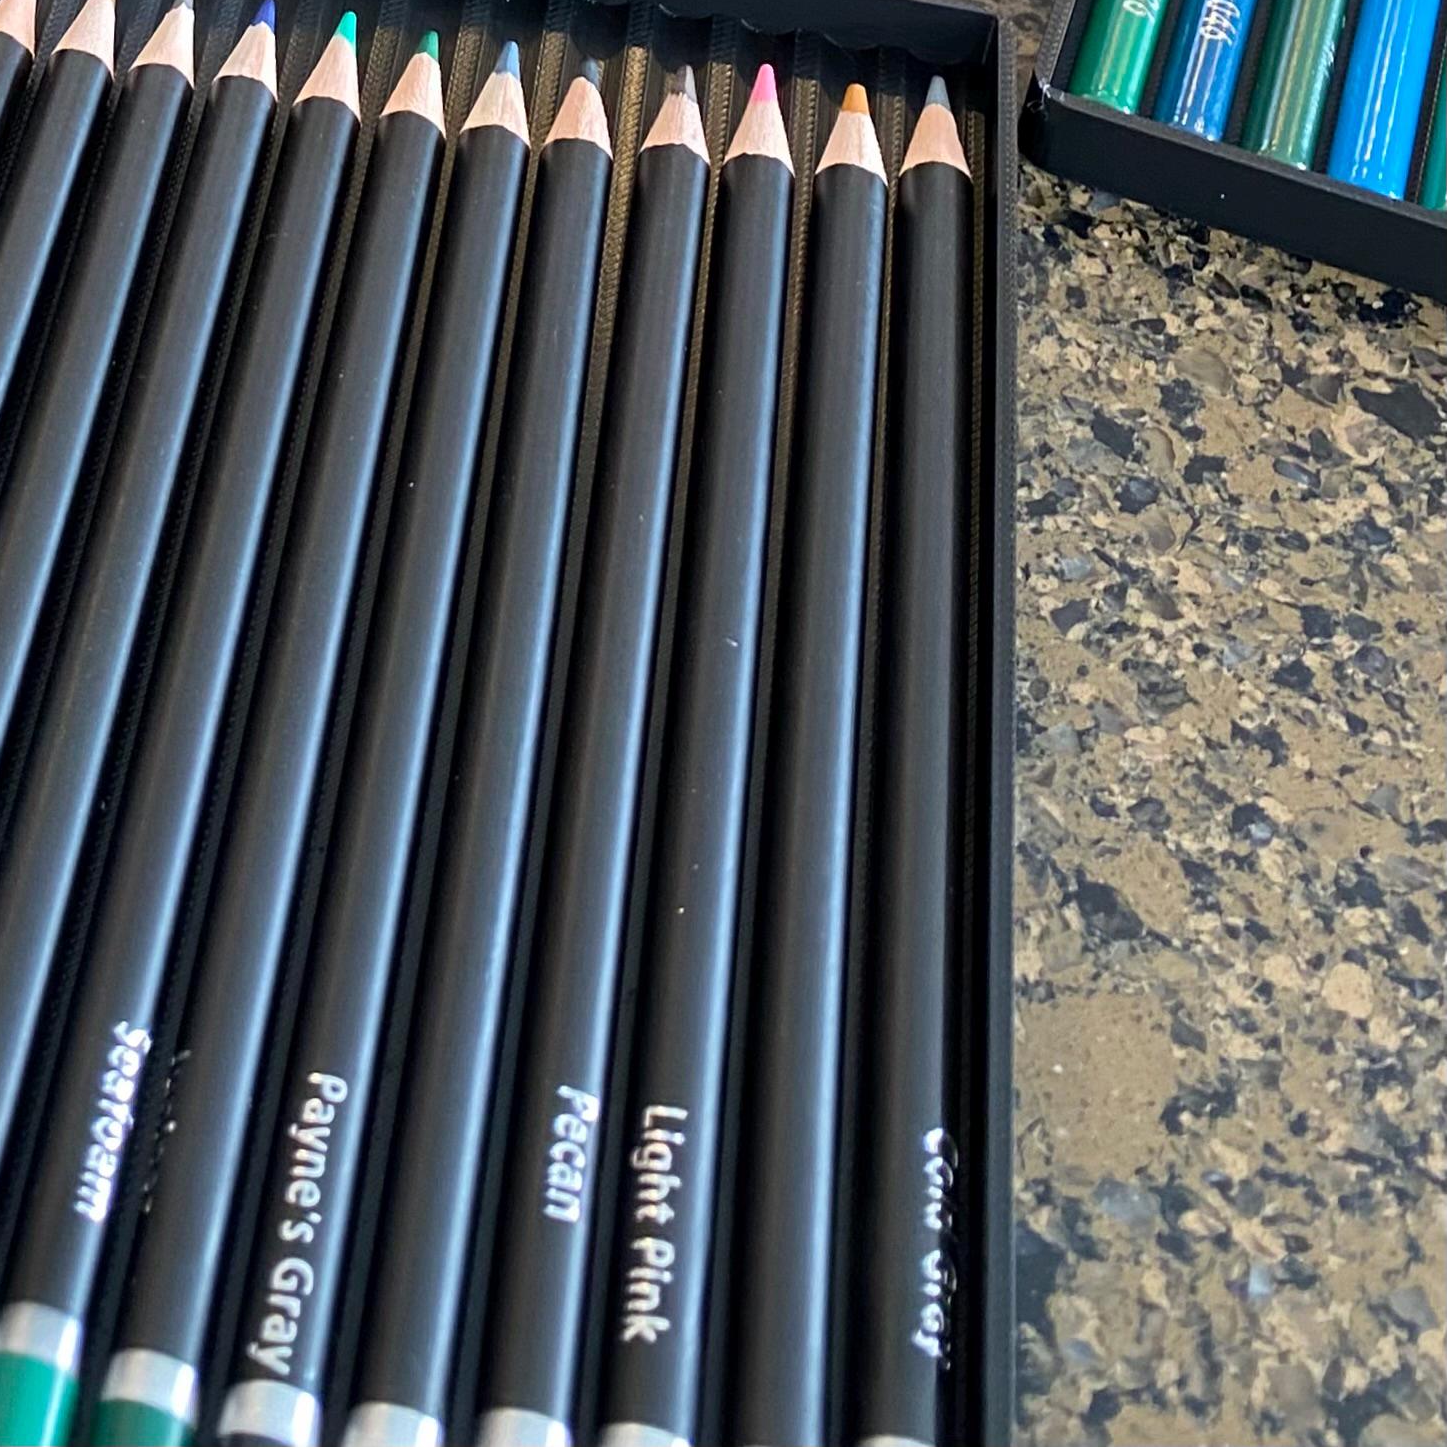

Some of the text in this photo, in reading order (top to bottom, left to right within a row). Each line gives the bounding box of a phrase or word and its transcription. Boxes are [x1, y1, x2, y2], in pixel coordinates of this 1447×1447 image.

[245, 1070, 348, 1377] Payne's Gray
[542, 1084, 601, 1224] Pecan
[619, 1103, 689, 1345] Light Pink
